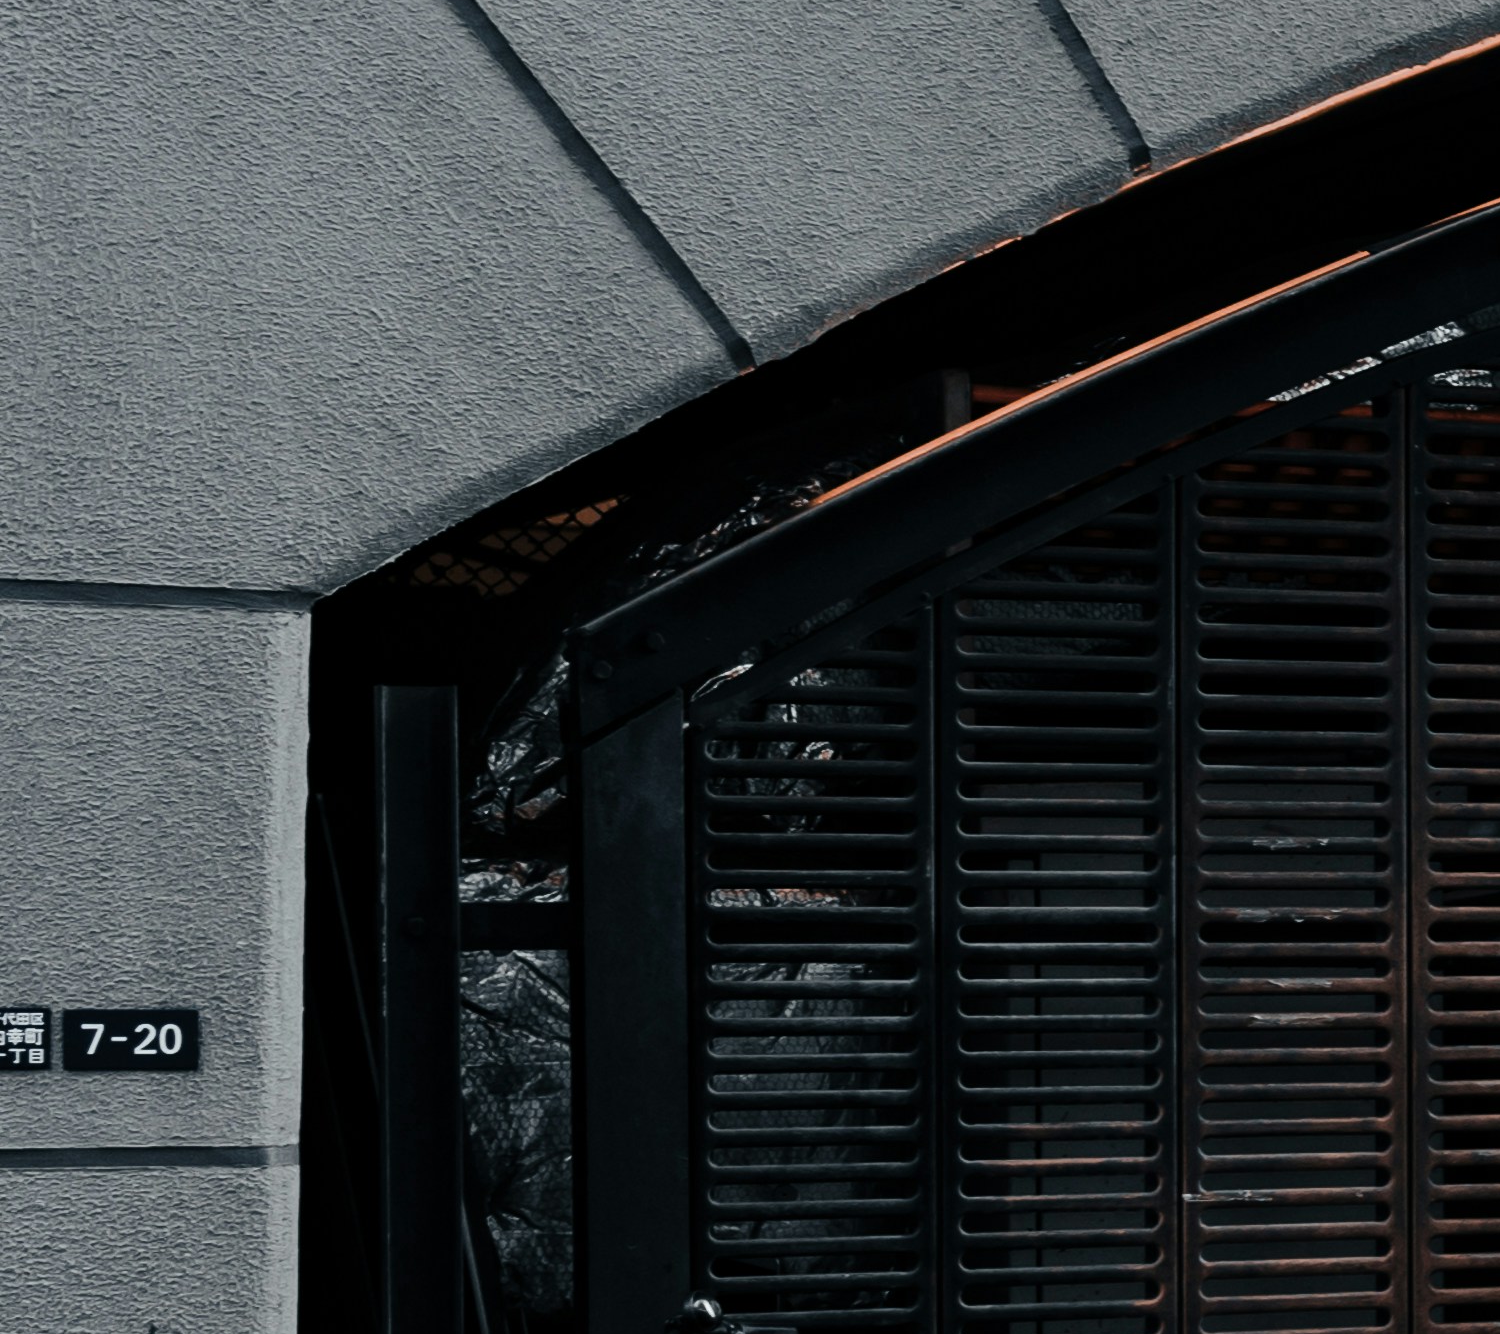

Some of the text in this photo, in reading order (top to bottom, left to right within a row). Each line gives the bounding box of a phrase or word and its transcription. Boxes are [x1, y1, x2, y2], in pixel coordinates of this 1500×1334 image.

[0, 1013, 45, 1026] 代田区
[81, 1024, 183, 1055] 7-20
